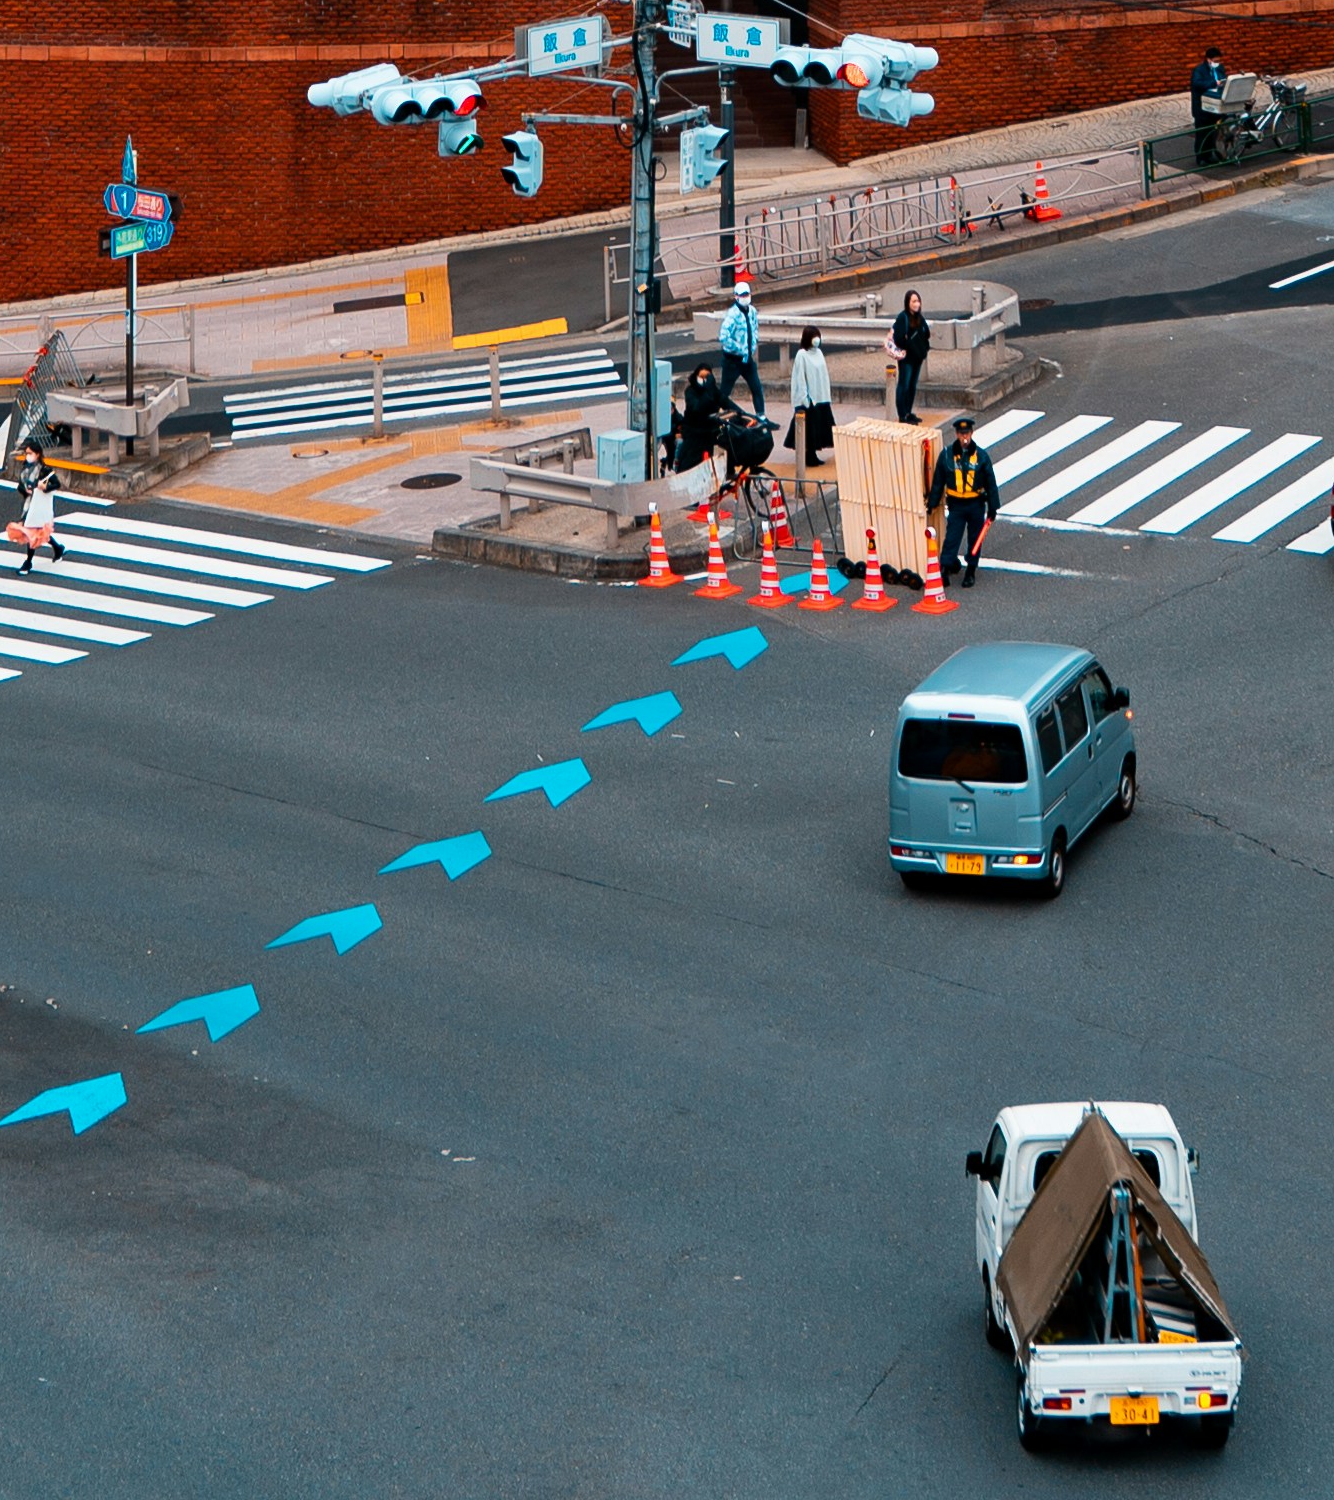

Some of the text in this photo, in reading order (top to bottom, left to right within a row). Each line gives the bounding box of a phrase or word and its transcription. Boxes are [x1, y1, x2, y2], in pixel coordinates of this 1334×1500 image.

[543, 27, 587, 52] 飯倉
[713, 22, 761, 46] 飯倉
[120, 191, 127, 209] 1
[146, 224, 163, 243] 319
